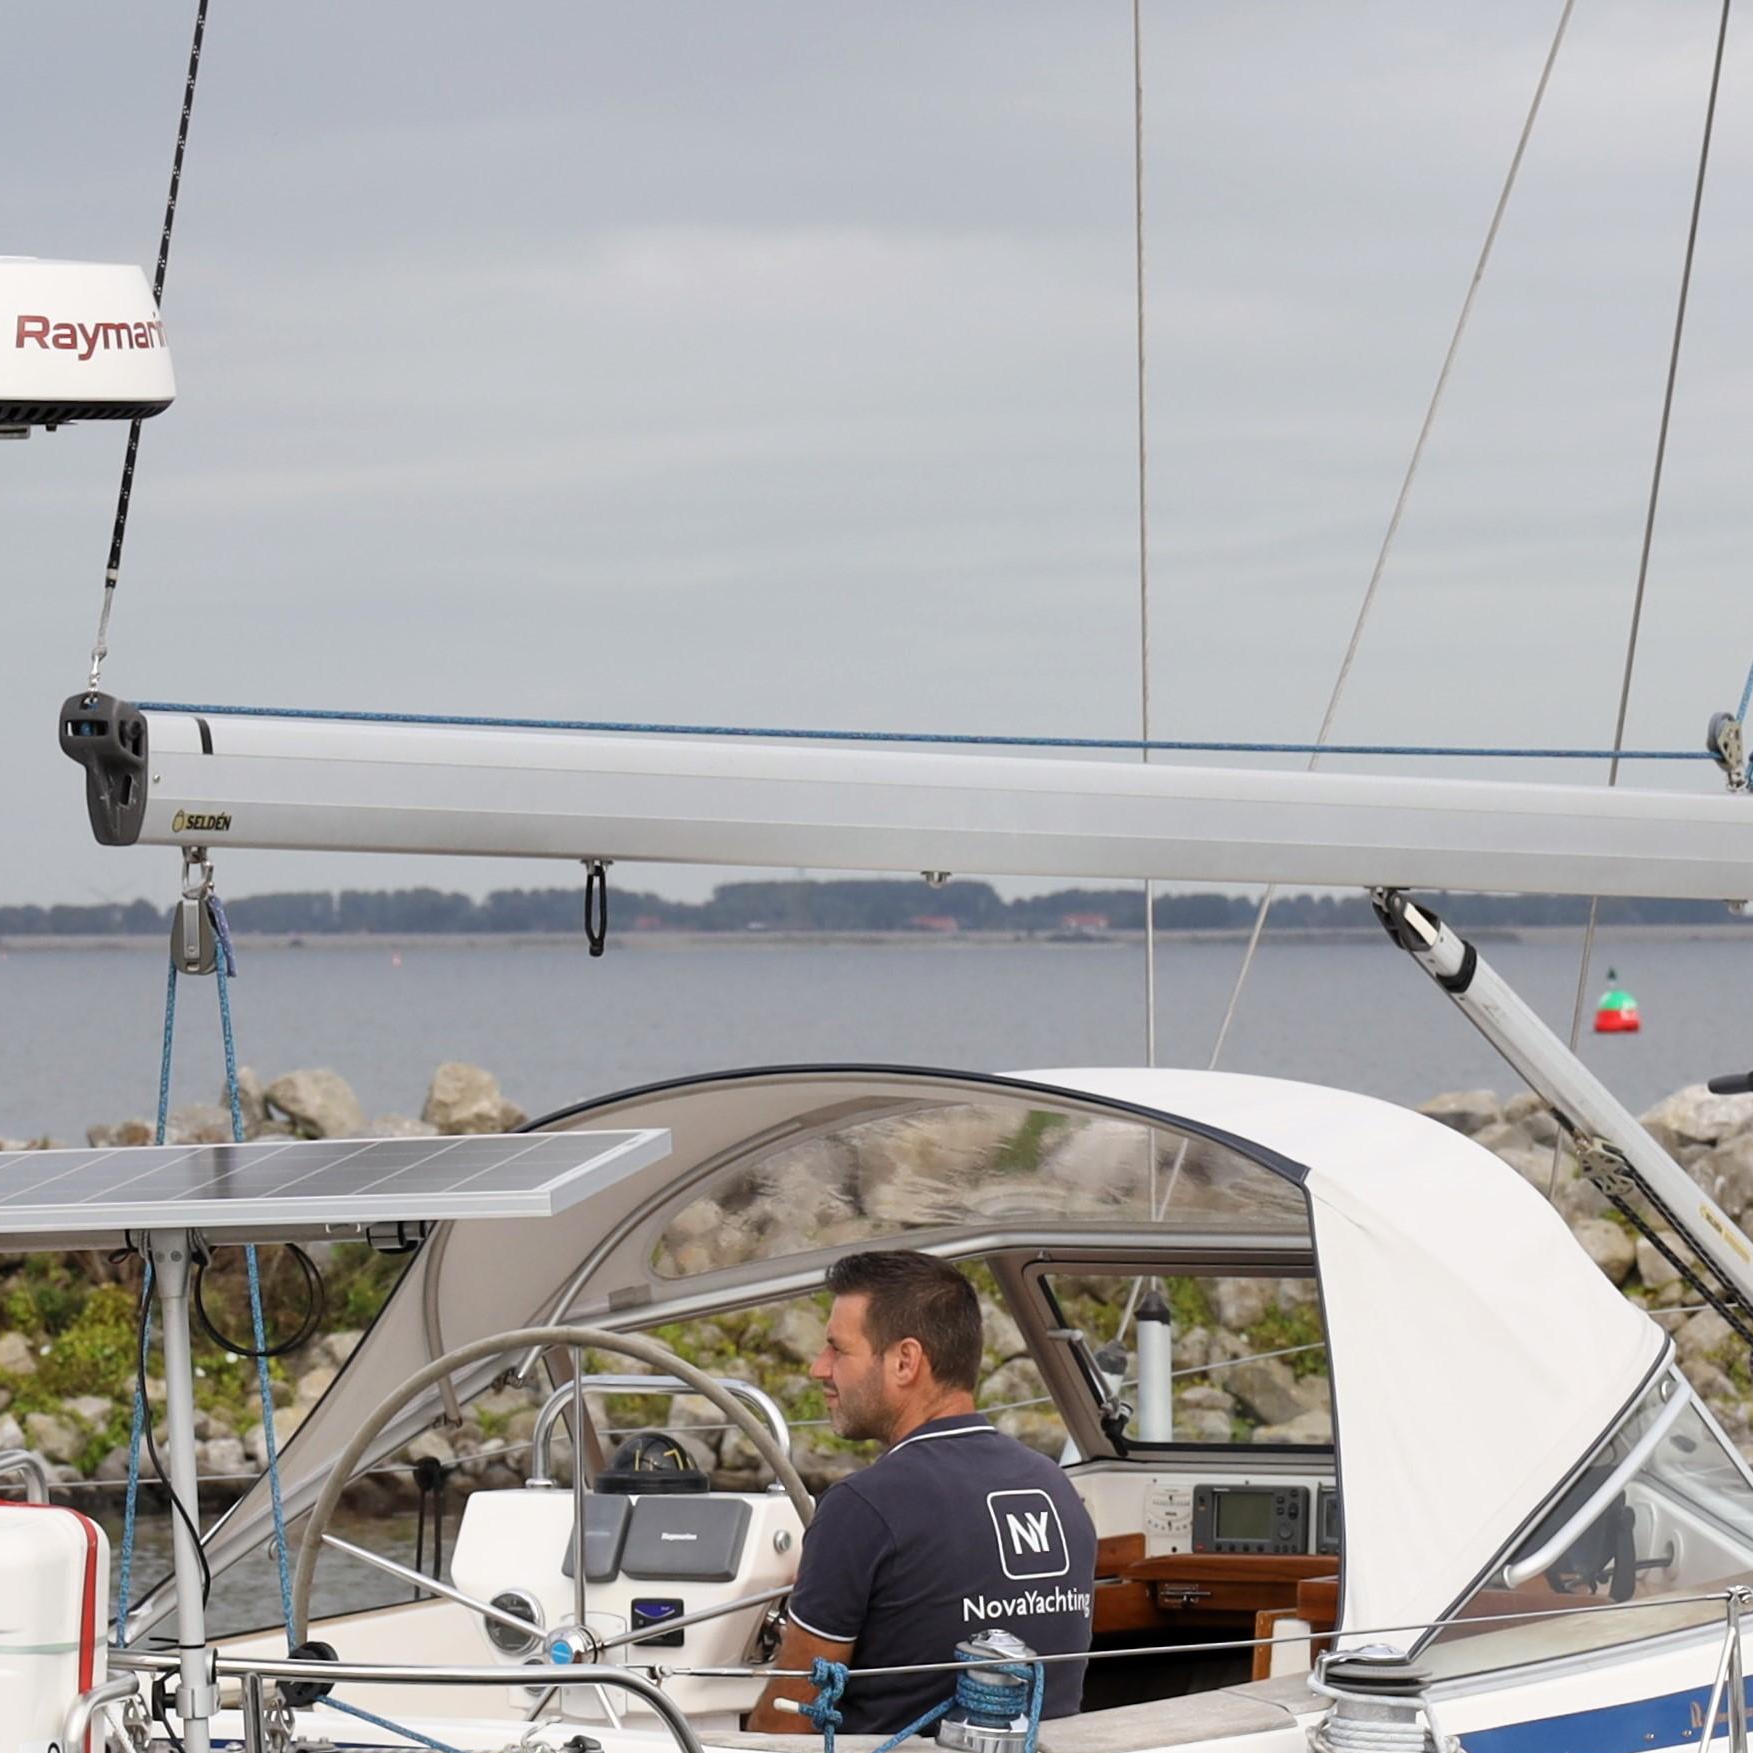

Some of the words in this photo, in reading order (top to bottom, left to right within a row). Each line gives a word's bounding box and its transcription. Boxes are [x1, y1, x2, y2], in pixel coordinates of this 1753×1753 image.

[185, 811, 232, 831] SELDÉN
[1005, 1511, 1050, 1555] NY
[963, 1586, 1090, 1622] NovaYachting
